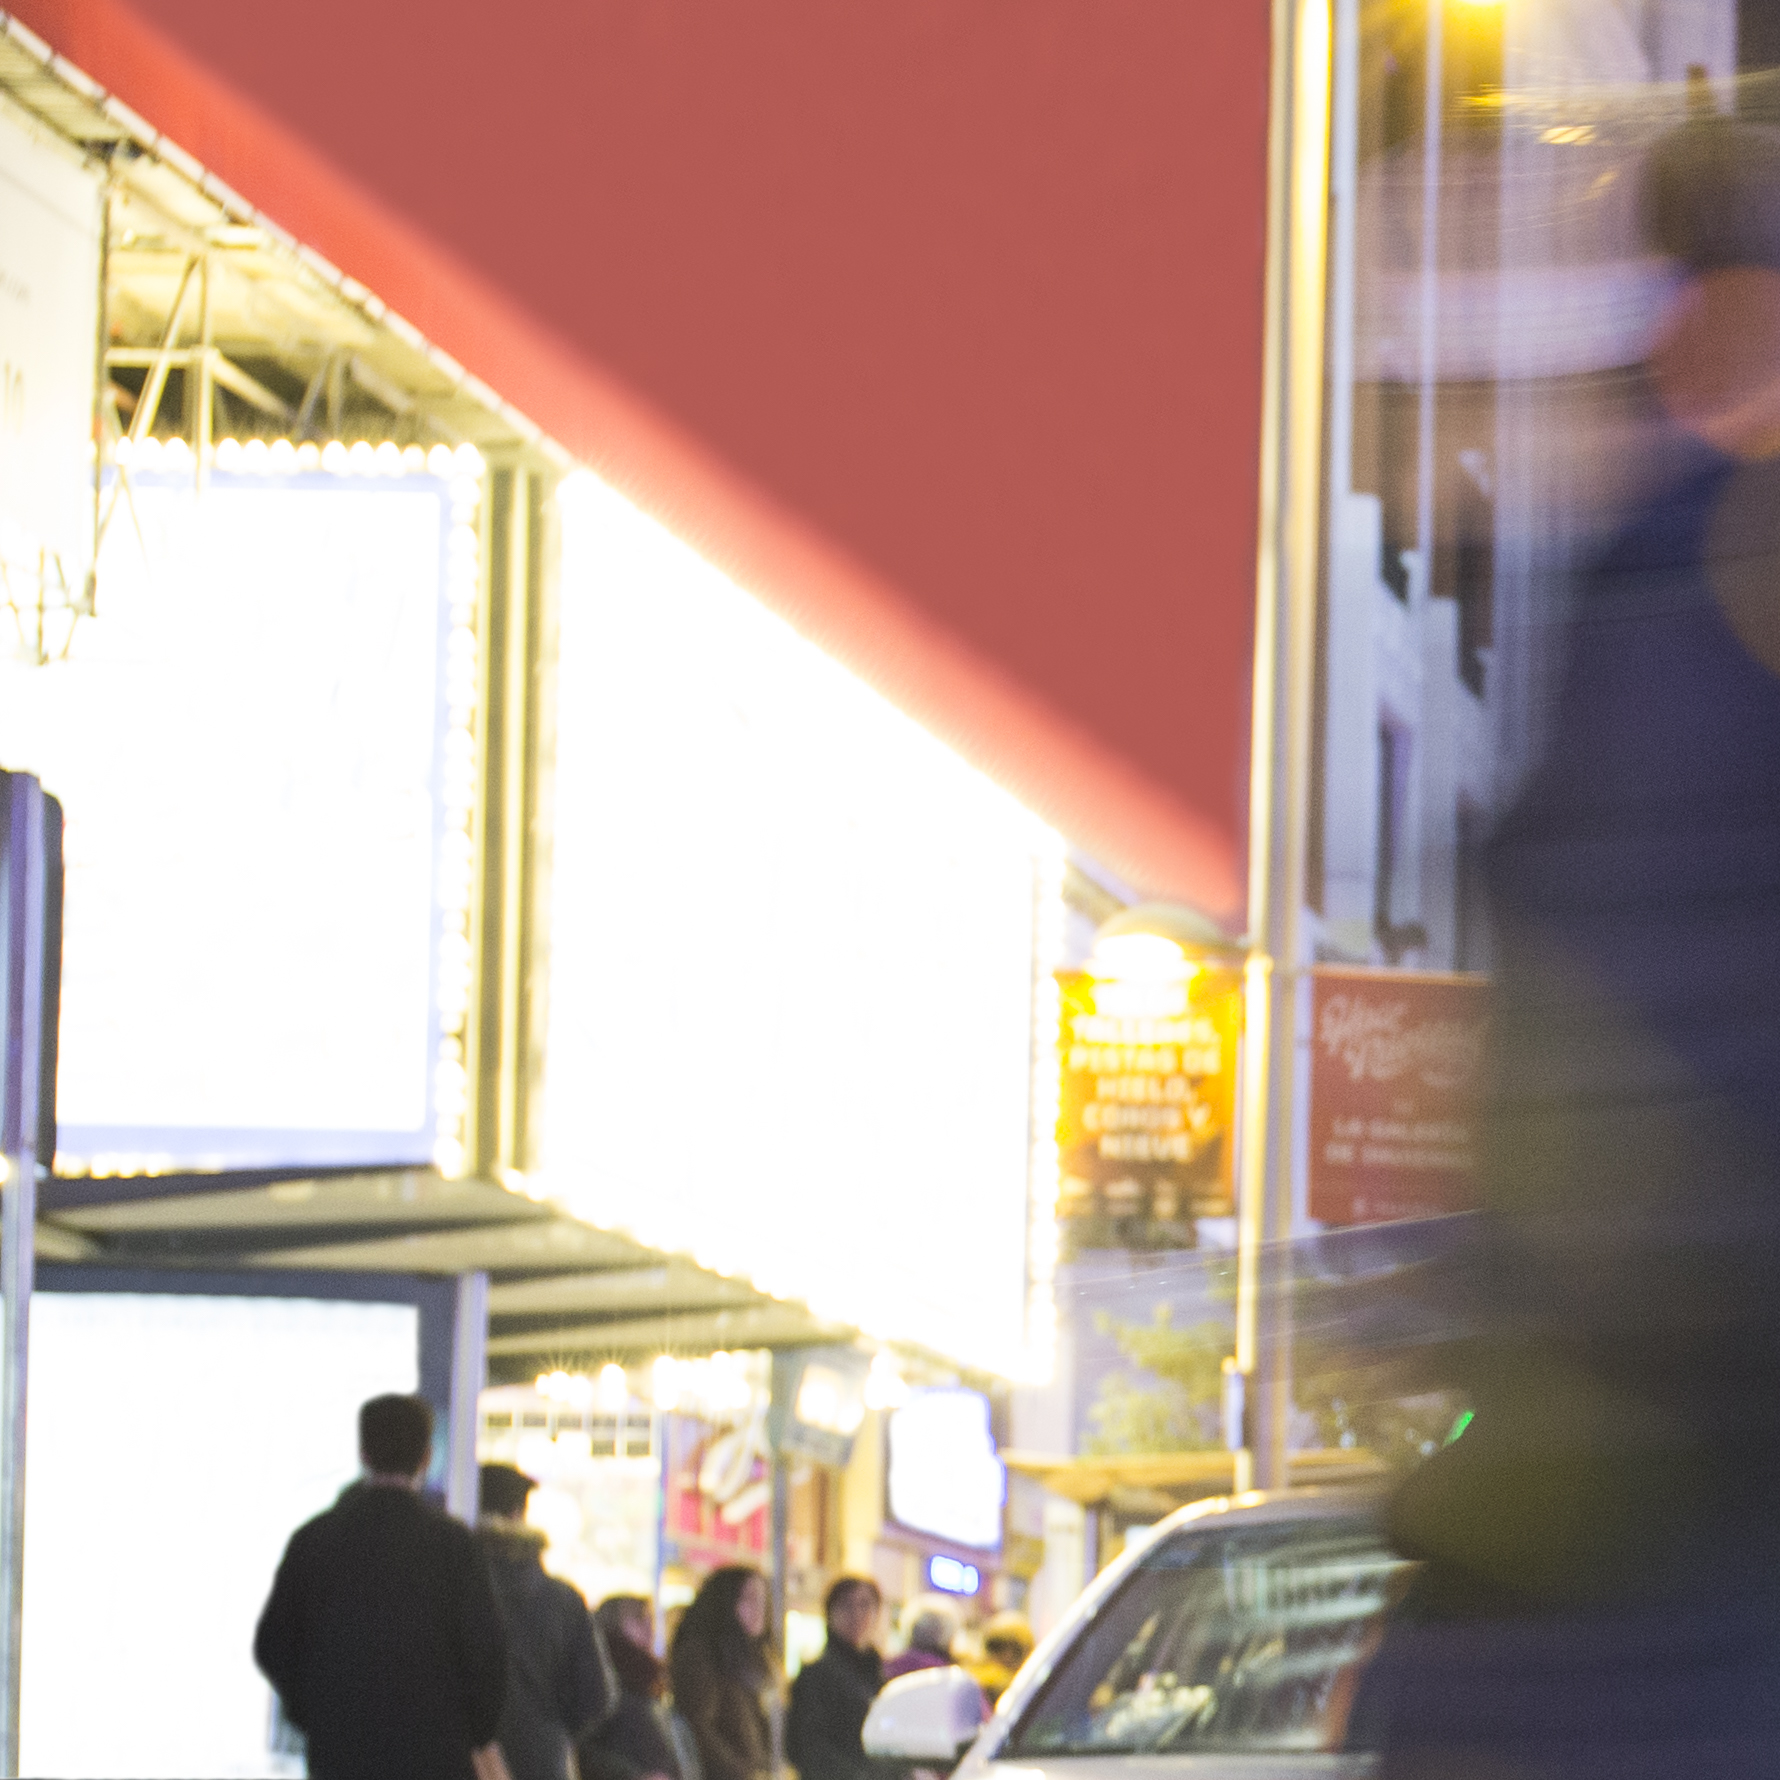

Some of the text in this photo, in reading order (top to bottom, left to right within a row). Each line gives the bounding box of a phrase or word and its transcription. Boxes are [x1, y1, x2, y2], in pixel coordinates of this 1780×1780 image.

[1069, 1045, 1221, 1075] PISTAS DE
[1096, 1075, 1199, 1103] HIELO,
[1099, 1133, 1192, 1162] NIEVE
